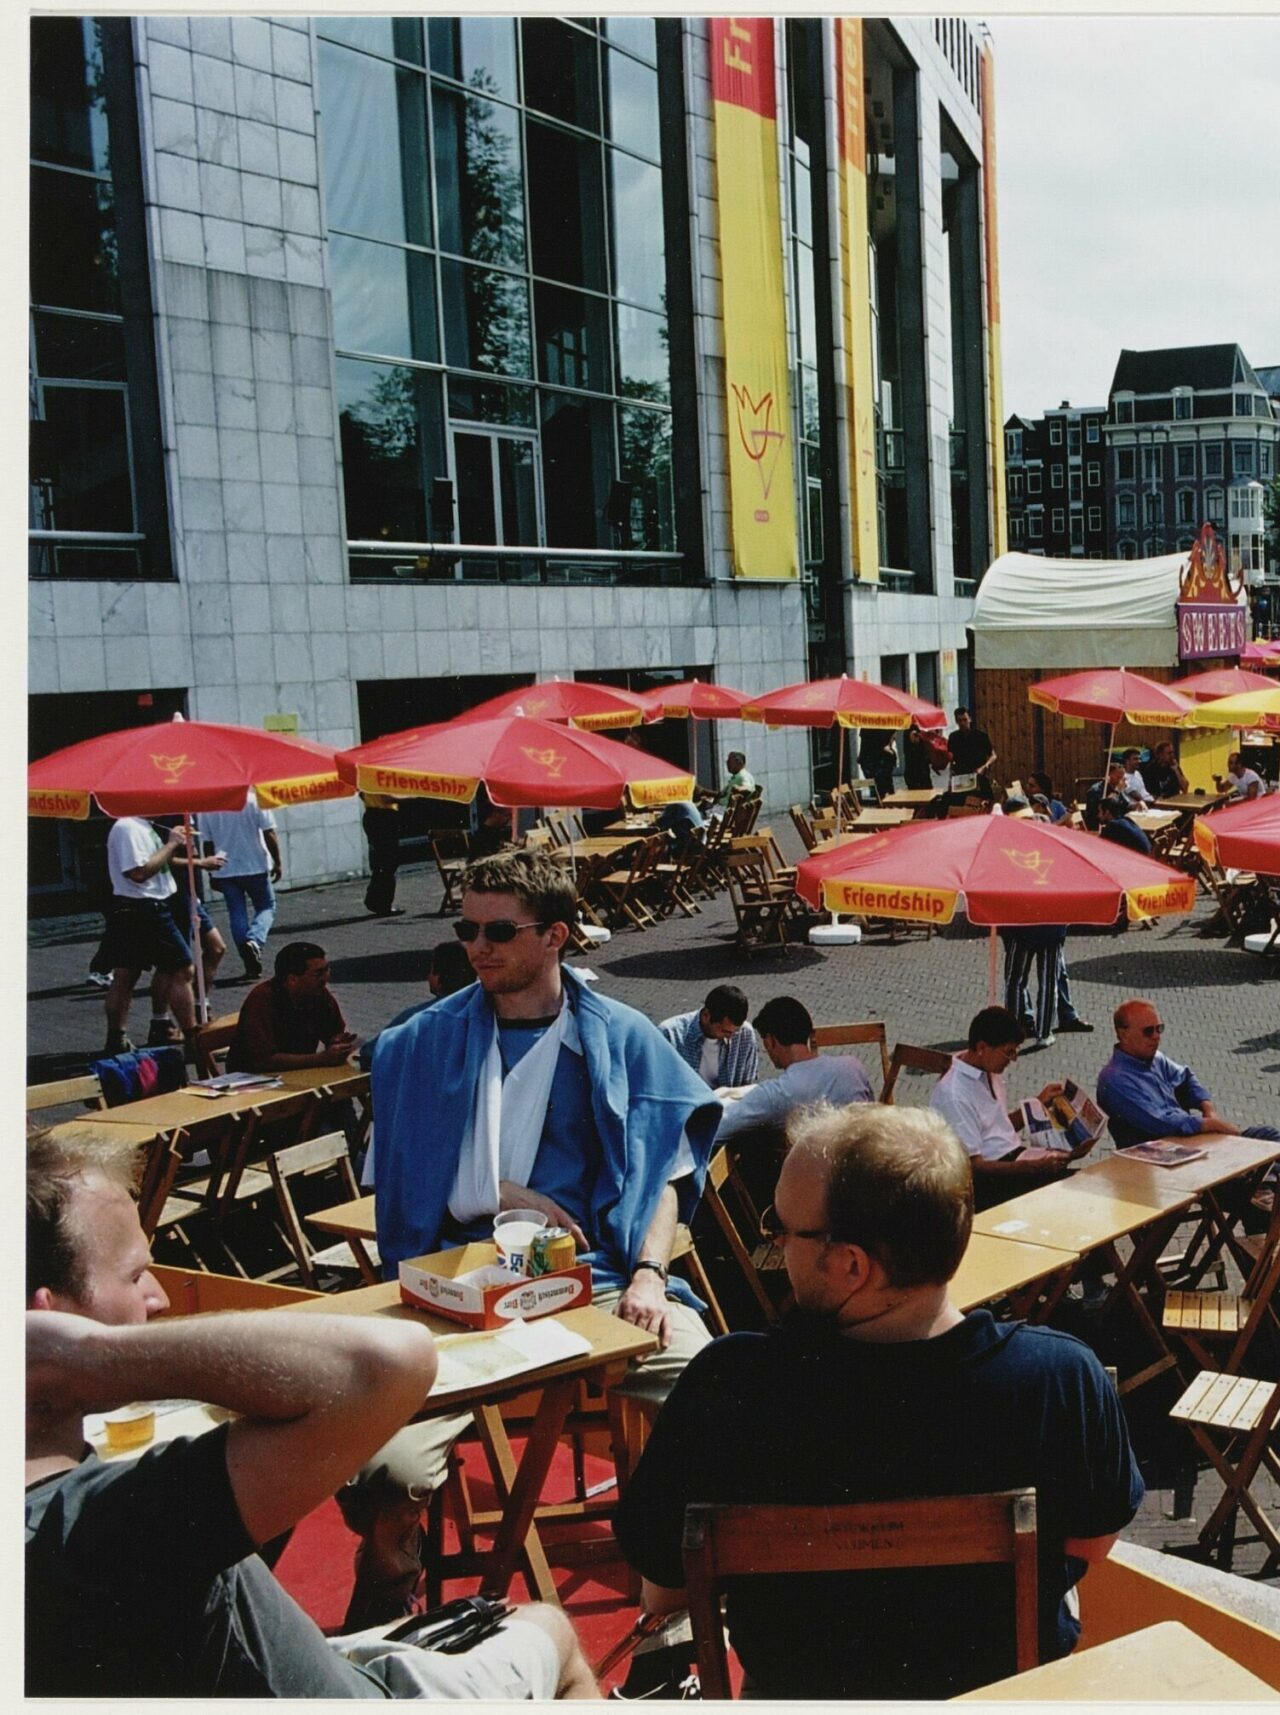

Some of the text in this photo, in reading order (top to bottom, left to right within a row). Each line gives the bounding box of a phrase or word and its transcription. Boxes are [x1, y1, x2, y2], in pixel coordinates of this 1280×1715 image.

[1182, 610, 1245, 655] SWEETS
[849, 713, 905, 727] Friendship
[269, 777, 346, 801] Friendship
[376, 770, 468, 796] Friendship
[843, 886, 945, 918] Friendship
[1137, 887, 1189, 909] Friendship
